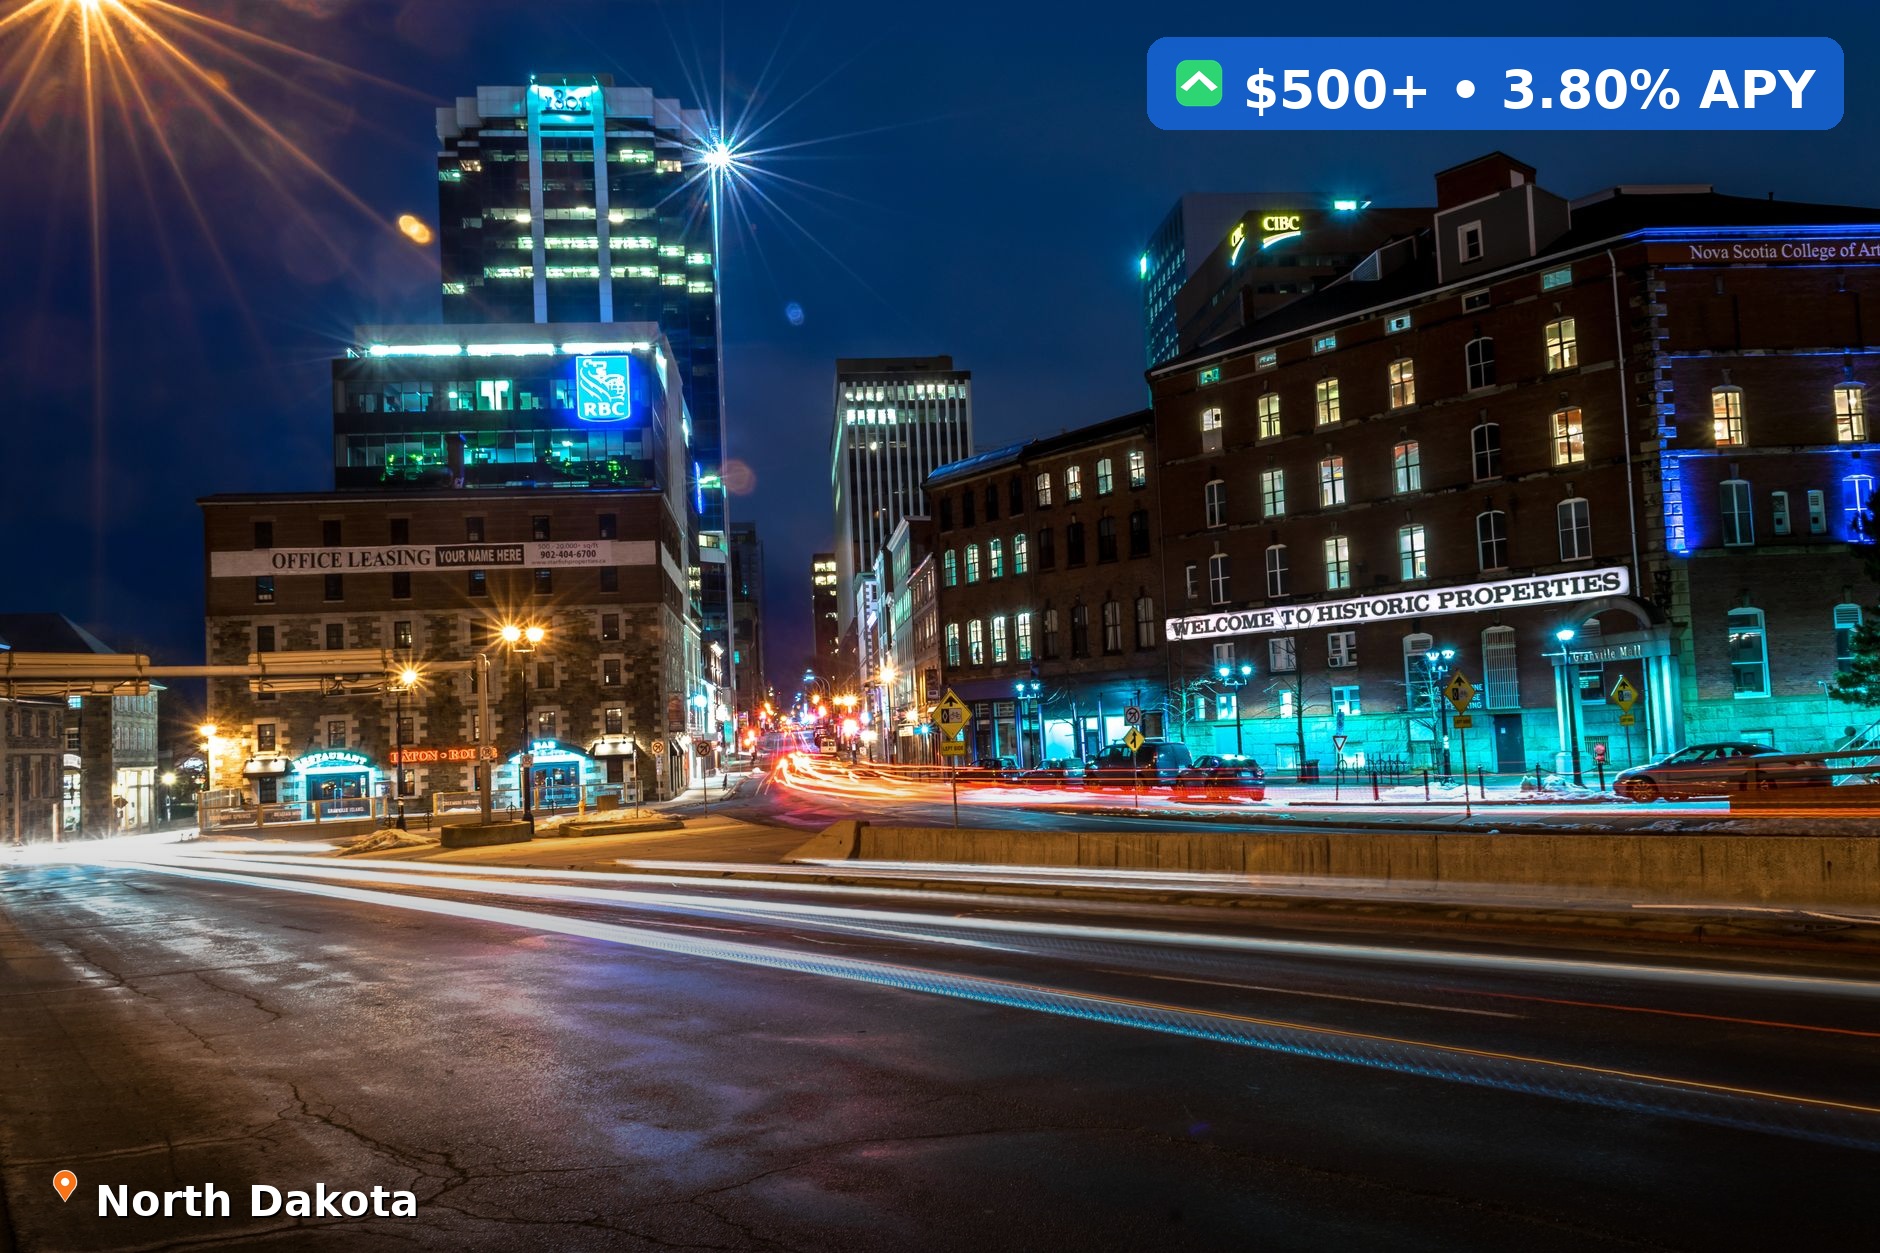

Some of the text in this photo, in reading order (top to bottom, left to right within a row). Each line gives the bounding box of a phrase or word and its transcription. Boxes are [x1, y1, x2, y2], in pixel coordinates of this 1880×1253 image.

[1263, 215, 1300, 231] CIBC
[1689, 242, 1880, 261] Nova Scotia College of Art
[583, 401, 625, 417] RBC
[272, 549, 432, 569] OFFICE LEASING
[438, 548, 522, 563] YOUR NAME HERE
[540, 549, 597, 559] 902-404-6700
[1171, 571, 1621, 637] WELCOME TO HISTORIC PROPERTIES
[1573, 644, 1641, 662] Granville Mall
